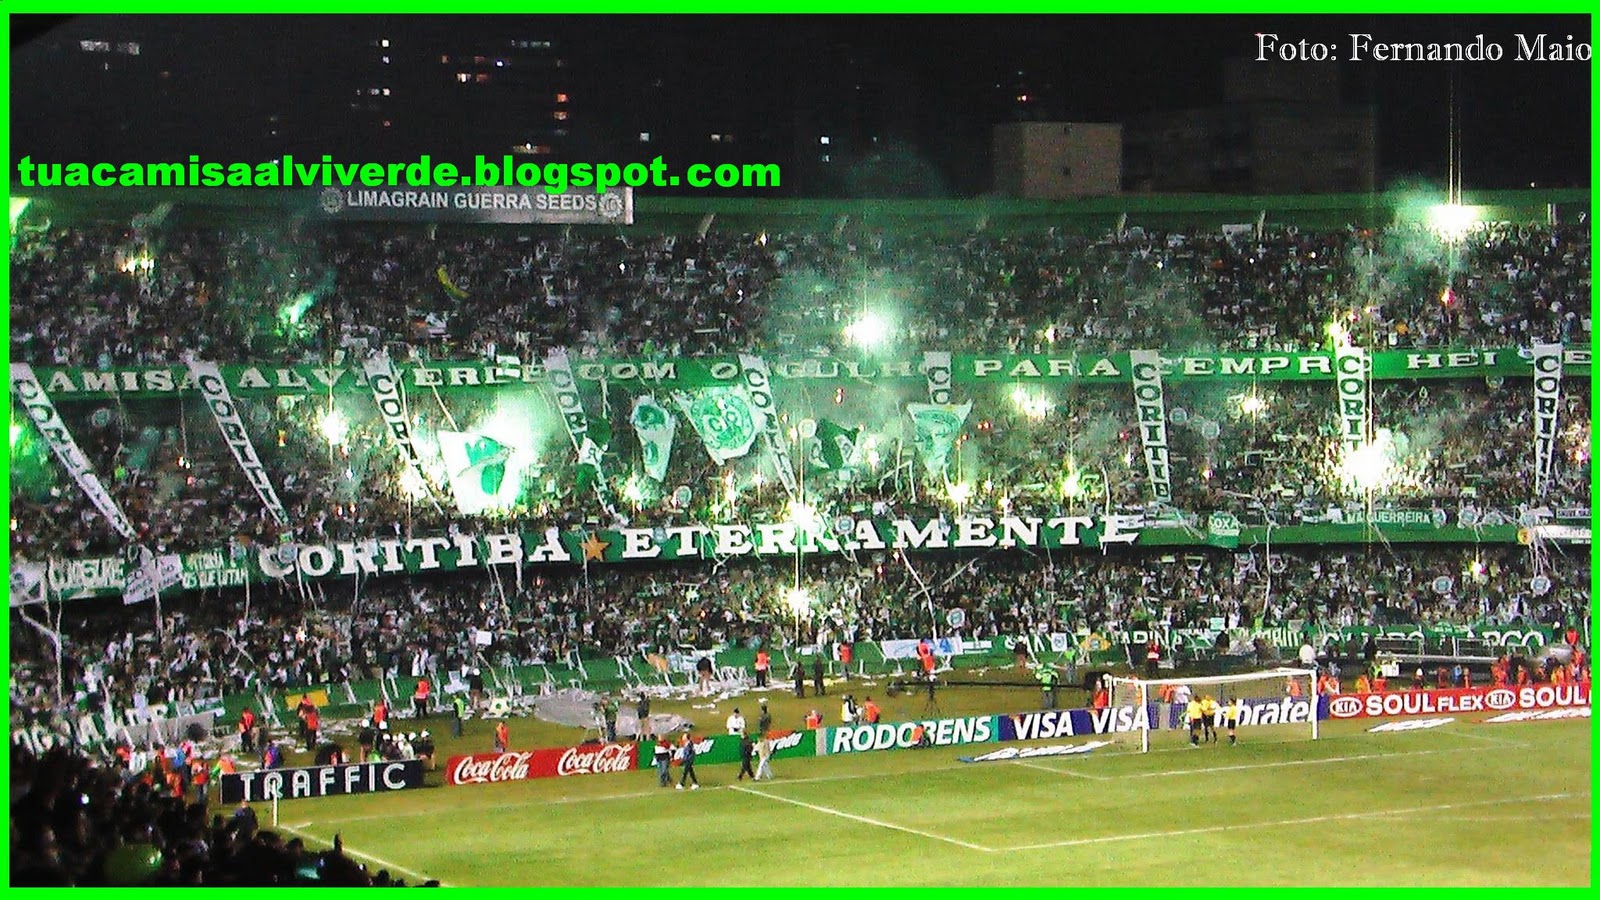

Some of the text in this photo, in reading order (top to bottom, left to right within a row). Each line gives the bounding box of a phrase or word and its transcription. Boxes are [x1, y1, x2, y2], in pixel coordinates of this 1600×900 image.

[347, 190, 597, 211] LIMAGRAIN GUERRA SEEDS
[47, 370, 200, 392] AMISA
[578, 362, 677, 381] COM
[974, 358, 1121, 376] PARA
[1407, 351, 1496, 369] HEI
[258, 512, 1140, 578] CORITIBA ETERNAMENTE
[1366, 694, 1436, 715] SOUL
[1438, 695, 1484, 712] FLEX
[1519, 686, 1587, 709] SOUL
[1013, 711, 1075, 741] VISA
[1091, 704, 1150, 735] VISA
[240, 763, 406, 802] TRAFFIC
